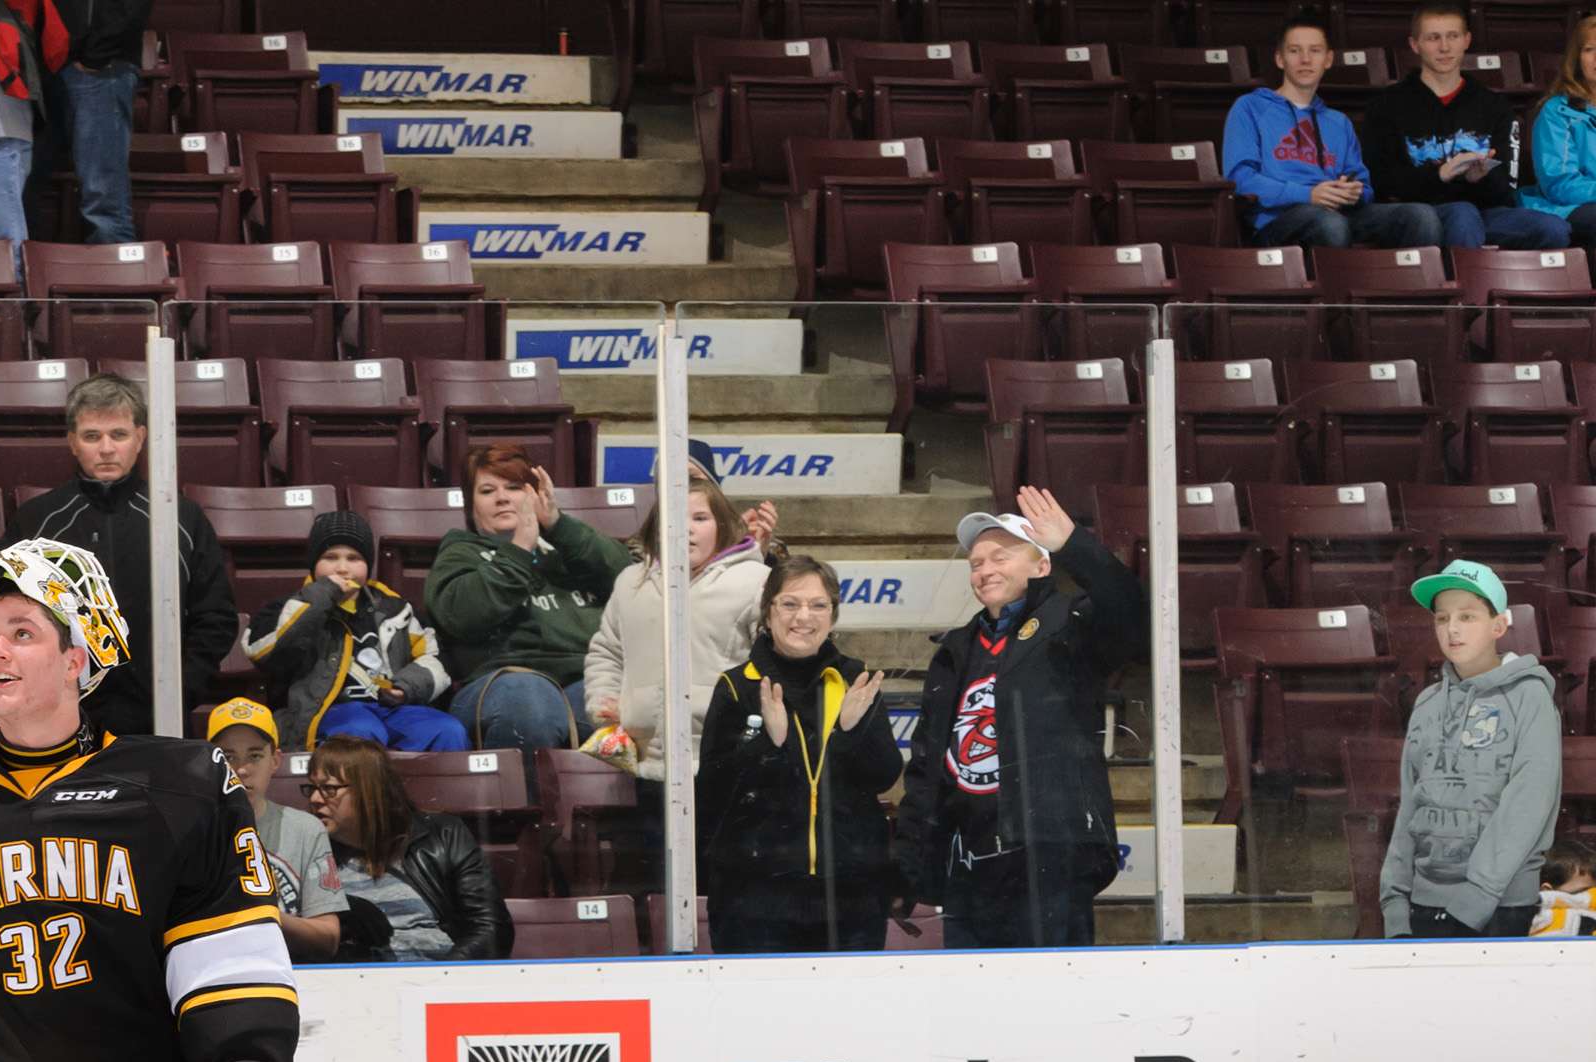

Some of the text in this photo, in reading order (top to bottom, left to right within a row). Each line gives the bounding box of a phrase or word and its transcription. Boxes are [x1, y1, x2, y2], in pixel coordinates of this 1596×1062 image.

[360, 70, 527, 95] WINMAR
[396, 124, 533, 148] WINMAR
[471, 230, 646, 253] WINMAR
[568, 335, 712, 362] WINMR
[204, 366, 216, 374] 14
[362, 367, 374, 375] 15
[516, 365, 528, 373] 16
[292, 493, 304, 501] 14
[614, 492, 627, 501] 16
[476, 759, 489, 767] 14
[54, 789, 118, 803] CCM
[235, 827, 275, 896] 3
[585, 905, 598, 915] 14
